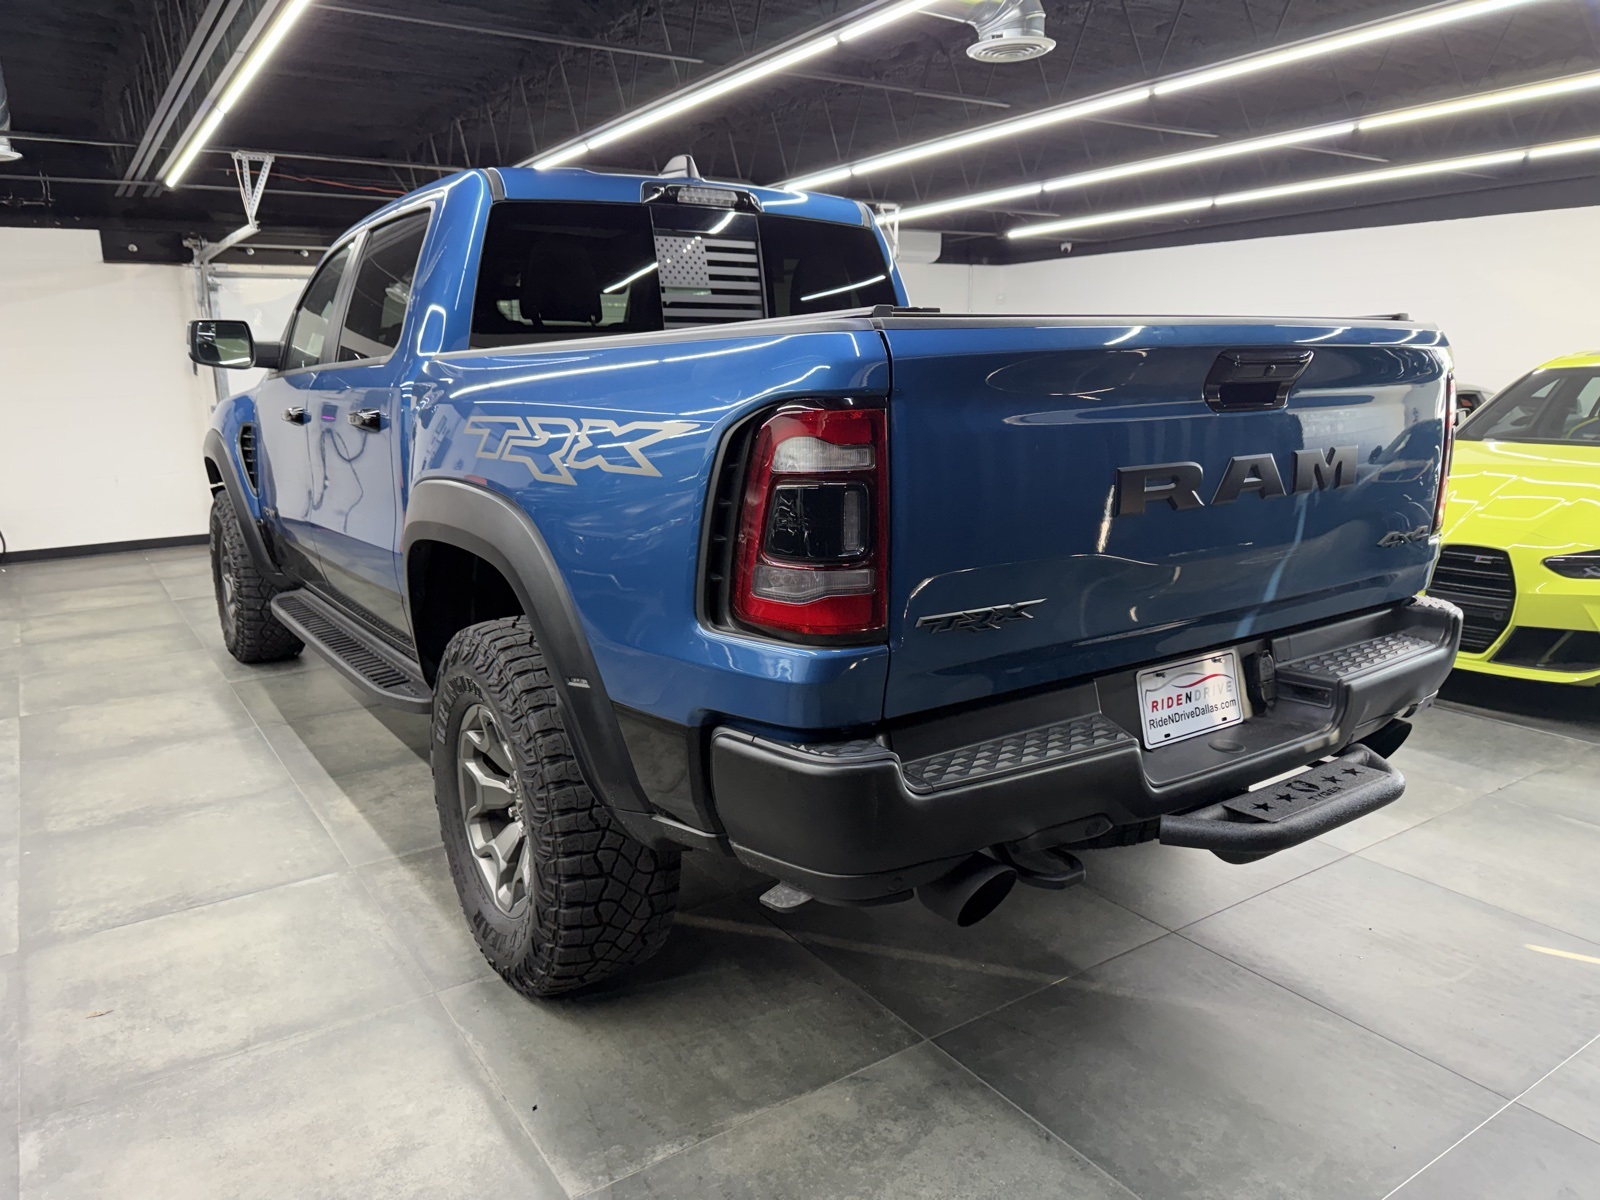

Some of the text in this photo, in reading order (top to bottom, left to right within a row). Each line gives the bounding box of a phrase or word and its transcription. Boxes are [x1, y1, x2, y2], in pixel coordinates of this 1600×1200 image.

[464, 416, 700, 486] TRX
[1114, 445, 1358, 518] RAM
[915, 598, 1047, 634] TRX
[1148, 698, 1237, 730] RideNDriveDallas.com
